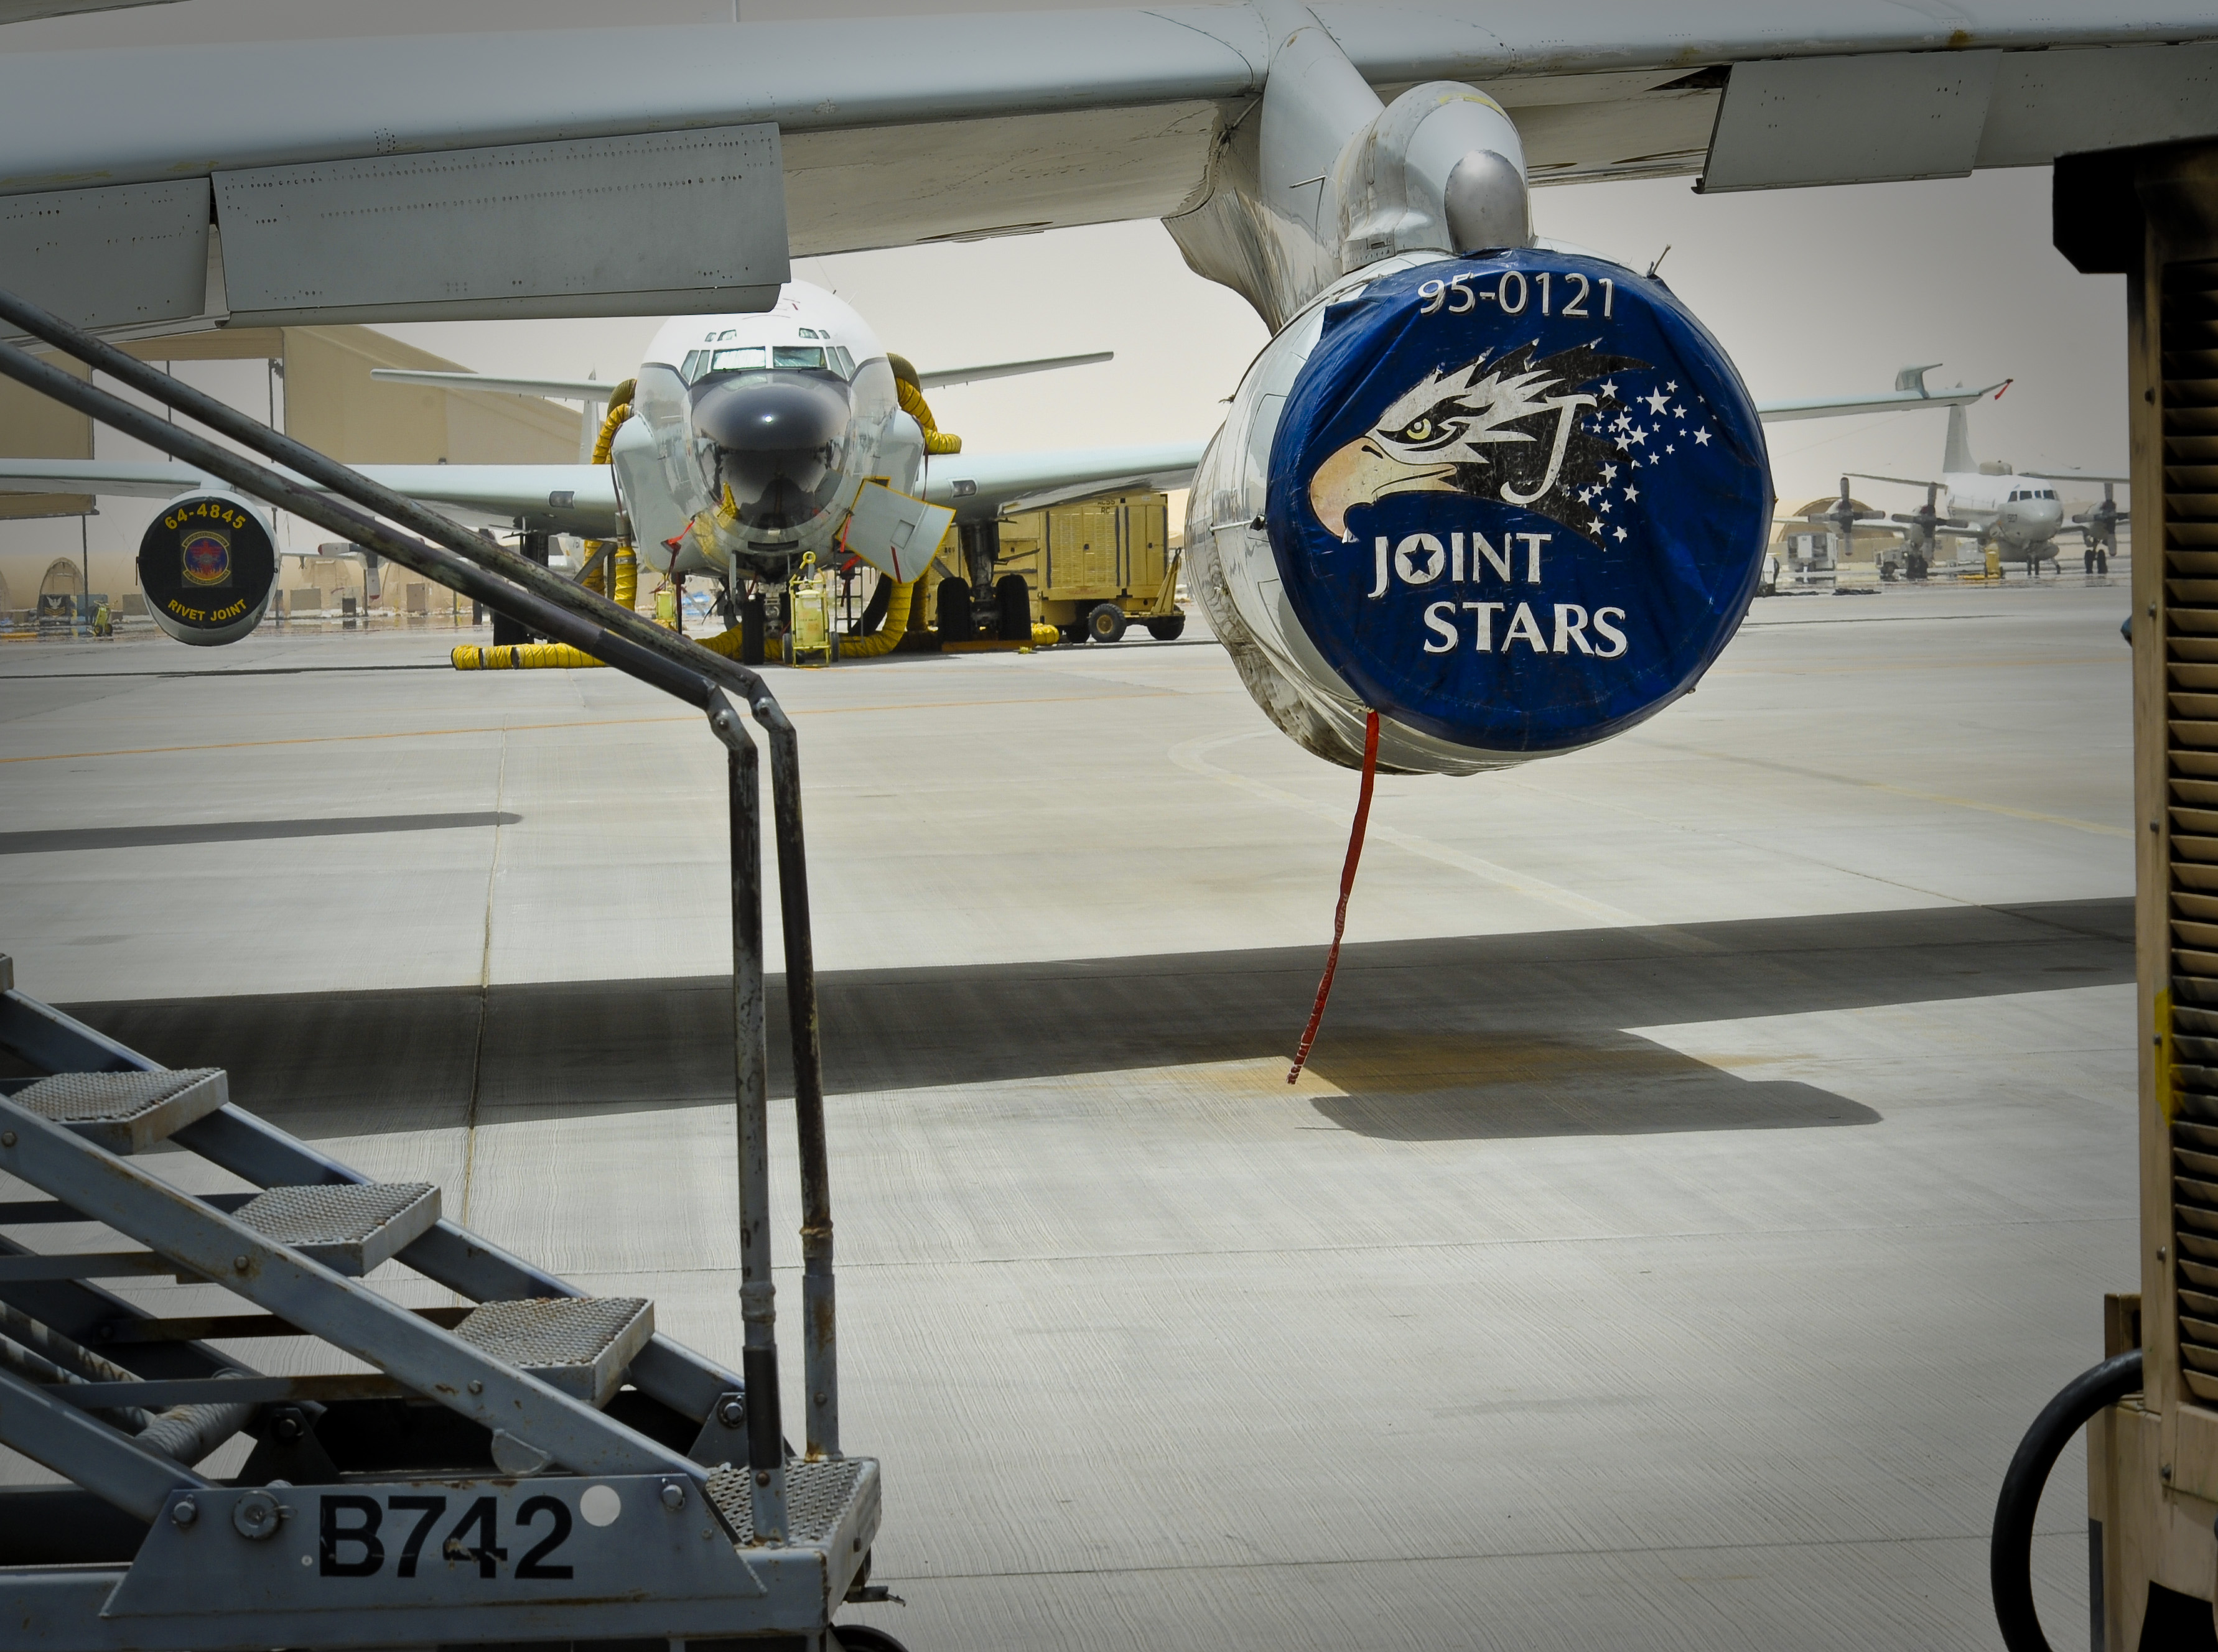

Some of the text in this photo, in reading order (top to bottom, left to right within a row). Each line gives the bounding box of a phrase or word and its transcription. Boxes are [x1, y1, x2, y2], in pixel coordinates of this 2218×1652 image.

[1417, 269, 1614, 317] 95-0121
[164, 503, 246, 529] 64-4845
[1368, 532, 1553, 599] JOINT
[167, 598, 247, 621] RIVET JOINT
[1424, 601, 1629, 657] STARS
[319, 1494, 574, 1579] B742
